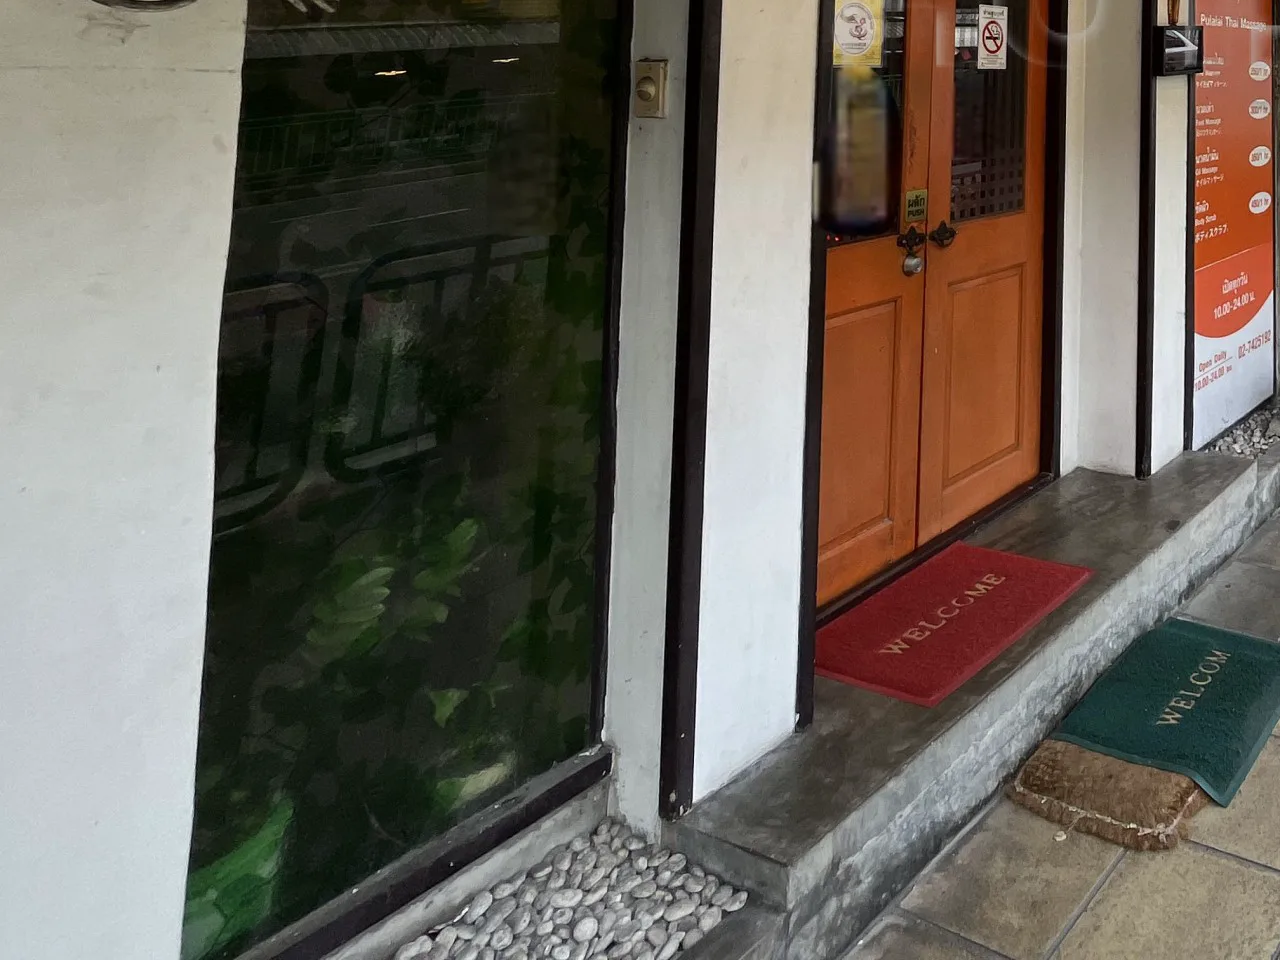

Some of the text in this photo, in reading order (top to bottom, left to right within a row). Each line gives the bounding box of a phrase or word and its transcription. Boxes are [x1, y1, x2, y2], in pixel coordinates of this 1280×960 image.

[1225, 15, 1239, 28] Thai
[1240, 17, 1267, 32] Massage
[908, 208, 925, 218] PUSH
[877, 572, 1007, 656] WELCOME
